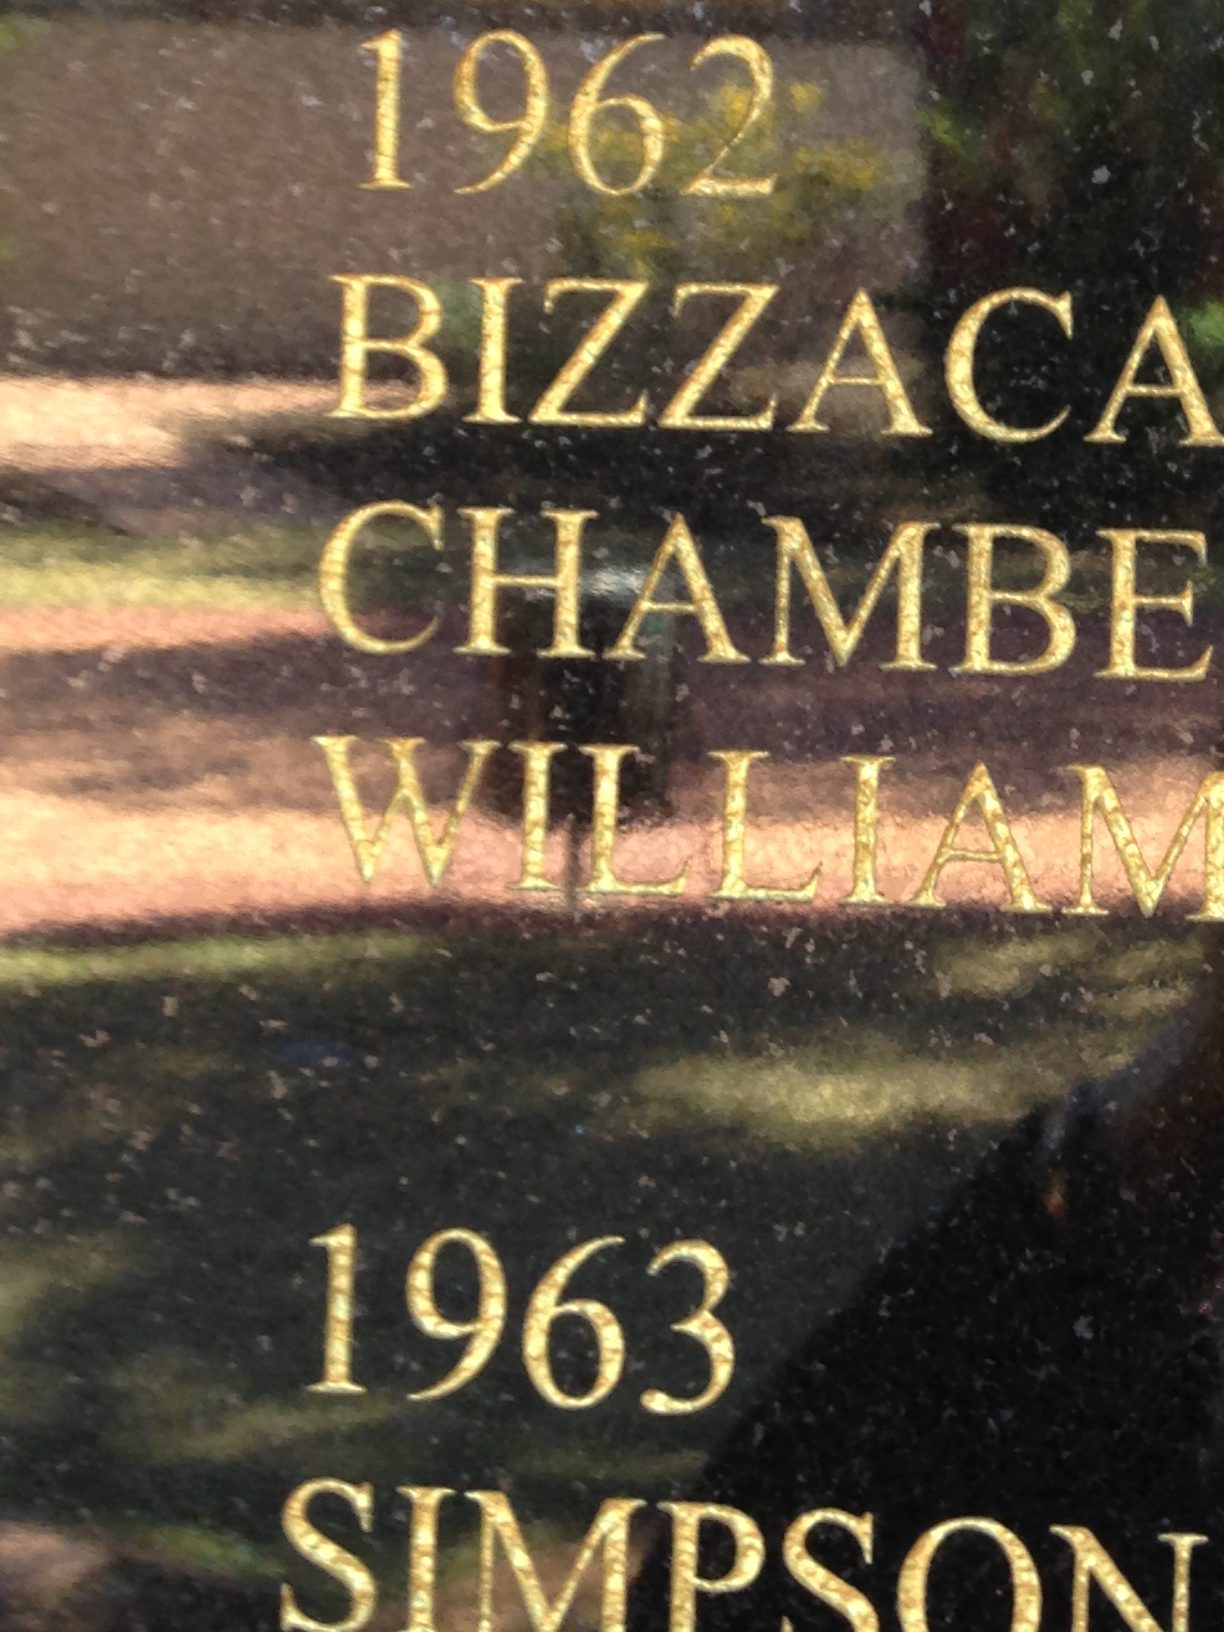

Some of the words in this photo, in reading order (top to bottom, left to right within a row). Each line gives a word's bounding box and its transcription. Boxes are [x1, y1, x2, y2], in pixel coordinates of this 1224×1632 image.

[356, 28, 781, 197] 1962
[307, 1223, 736, 1415] 1963
[279, 1476, 1208, 1632] SIMPSON
